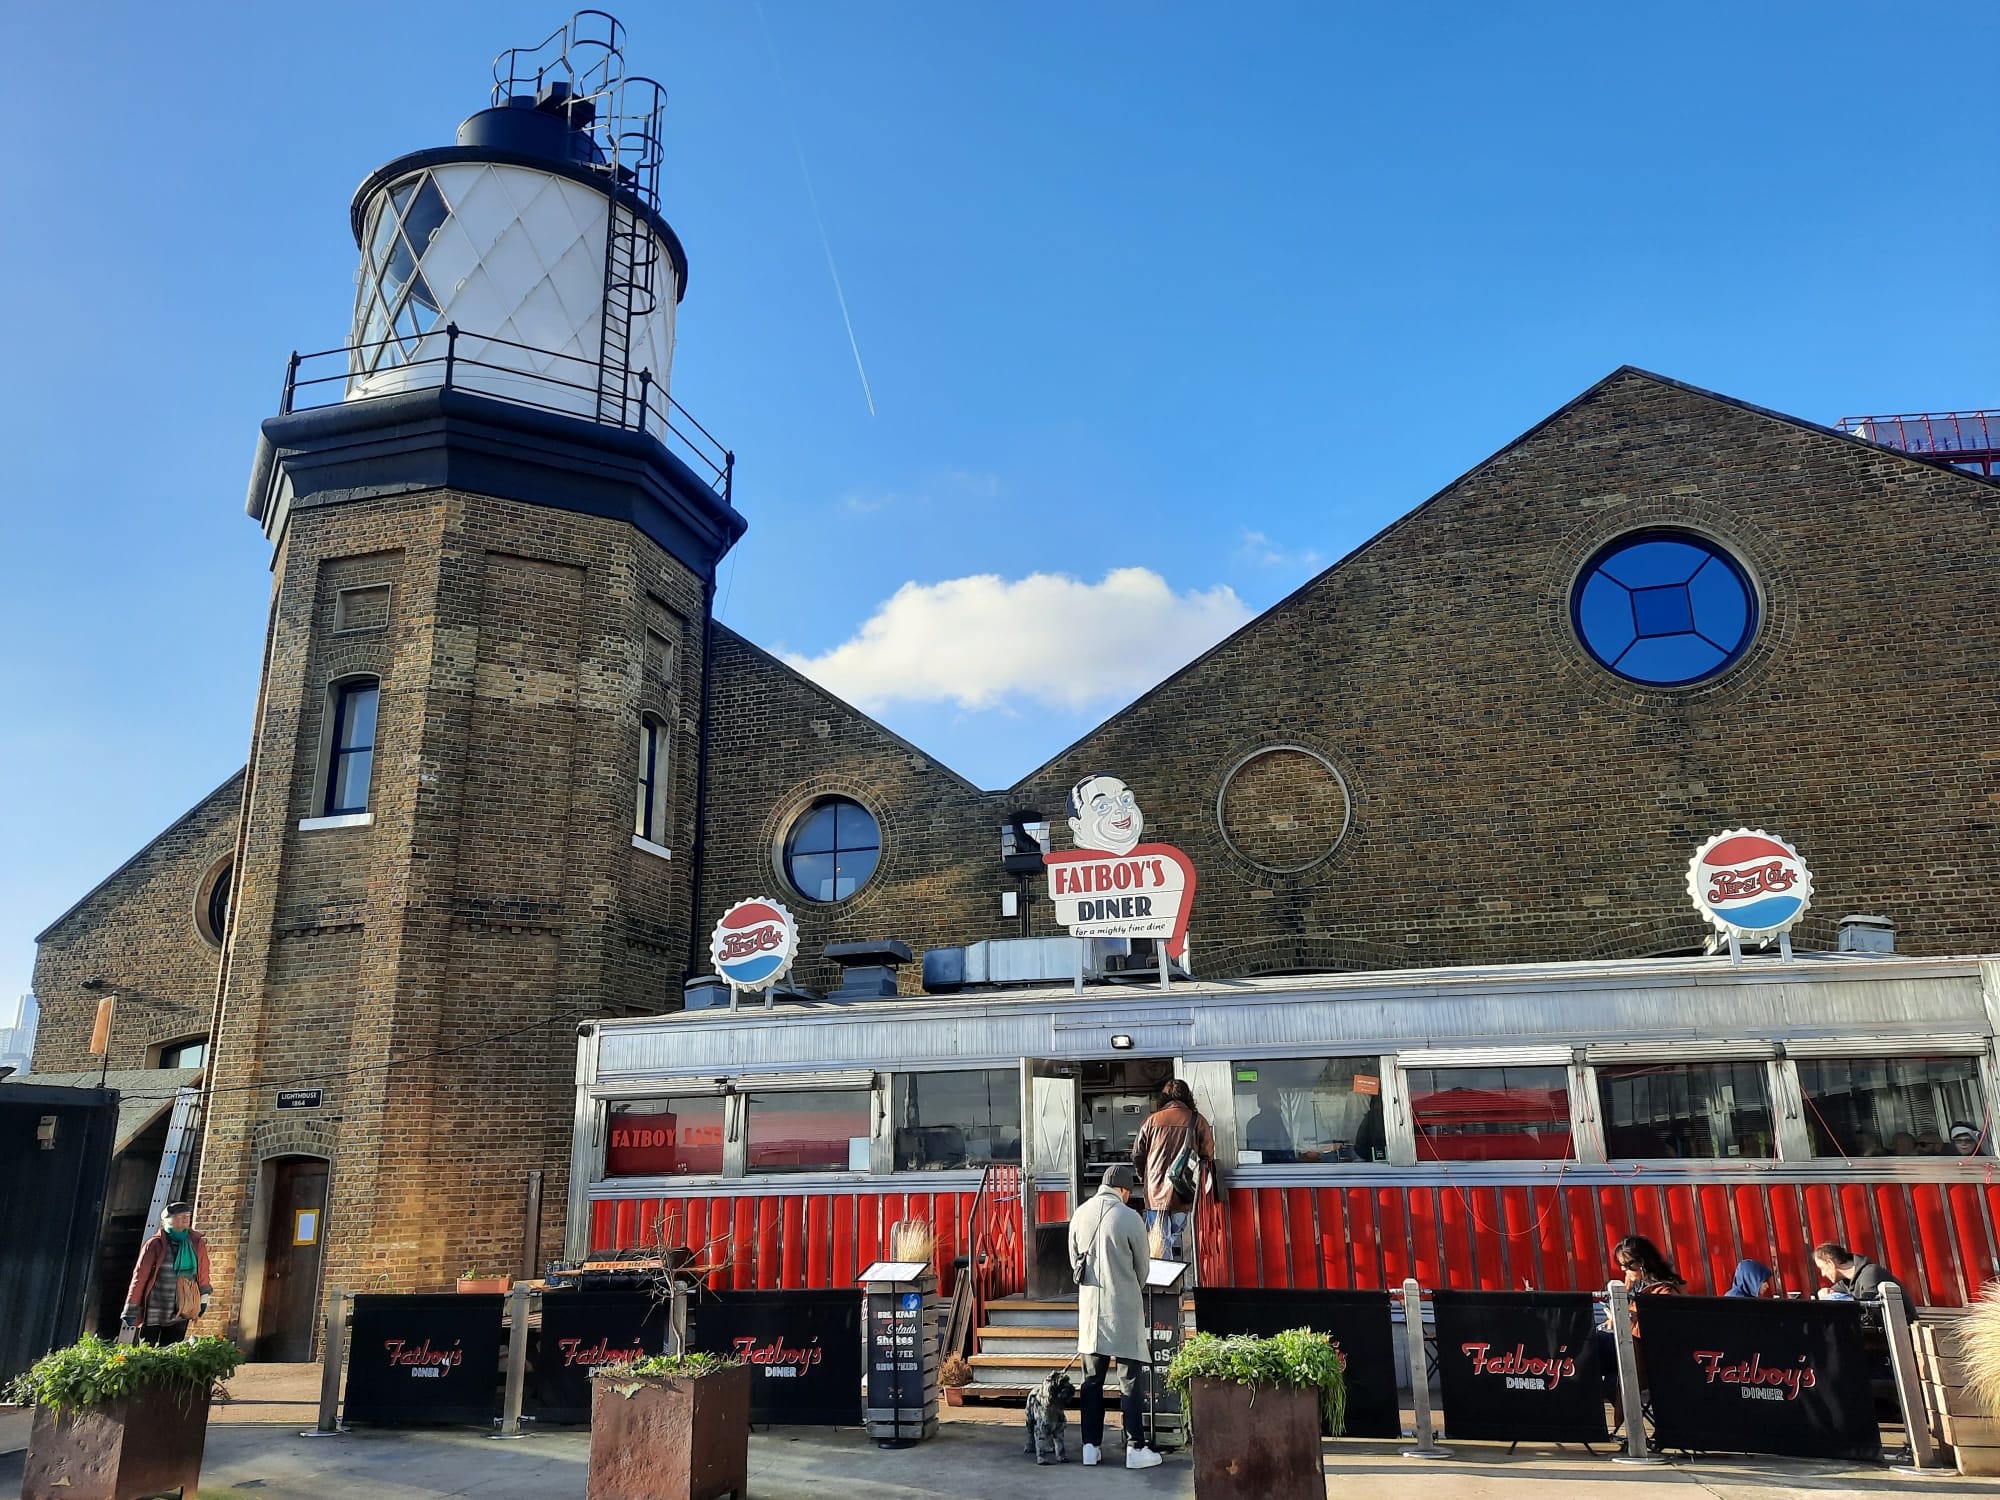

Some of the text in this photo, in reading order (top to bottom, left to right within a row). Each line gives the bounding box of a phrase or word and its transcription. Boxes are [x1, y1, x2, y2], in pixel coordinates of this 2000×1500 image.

[1055, 859, 1165, 895] FATBOY'S
[1078, 896, 1152, 922] DINER
[1075, 926, 1088, 936] for
[1097, 925, 1126, 935] mighty
[1128, 923, 1145, 933] fine
[1146, 922, 1166, 931] dine
[281, 1091, 318, 1100] LIGHTHOUSE
[384, 1338, 463, 1378] Fatboy's
[732, 1335, 822, 1377] Fatboy's
[885, 1350, 914, 1358] COFEE
[411, 1367, 440, 1378] DINER
[765, 1366, 797, 1378] DINER
[1461, 1342, 1576, 1390] Fatboy's
[1693, 1350, 1816, 1400] Fatboy's
[1505, 1376, 1546, 1391] DINER
[1741, 1386, 1784, 1400] DINER
